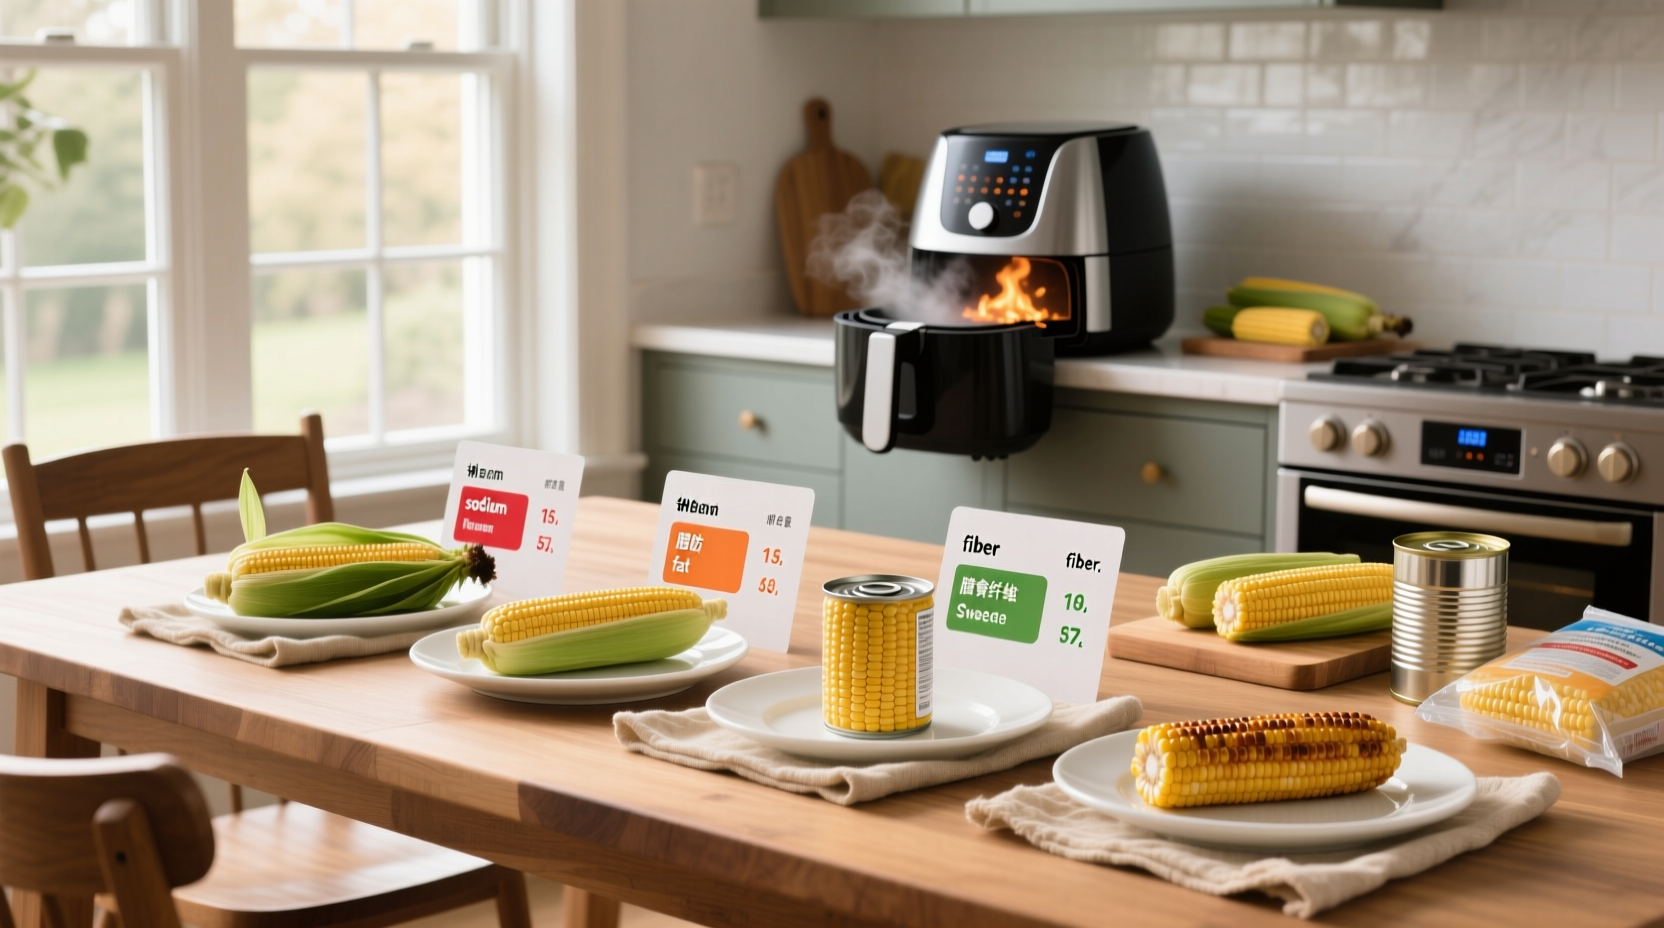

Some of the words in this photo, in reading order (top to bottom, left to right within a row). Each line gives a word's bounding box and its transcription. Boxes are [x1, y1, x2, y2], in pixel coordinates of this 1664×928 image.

[464, 496, 507, 515] sodium
[962, 534, 1001, 556] fiber
[671, 555, 690, 573] fat
[1066, 552, 1102, 573] fiber.
